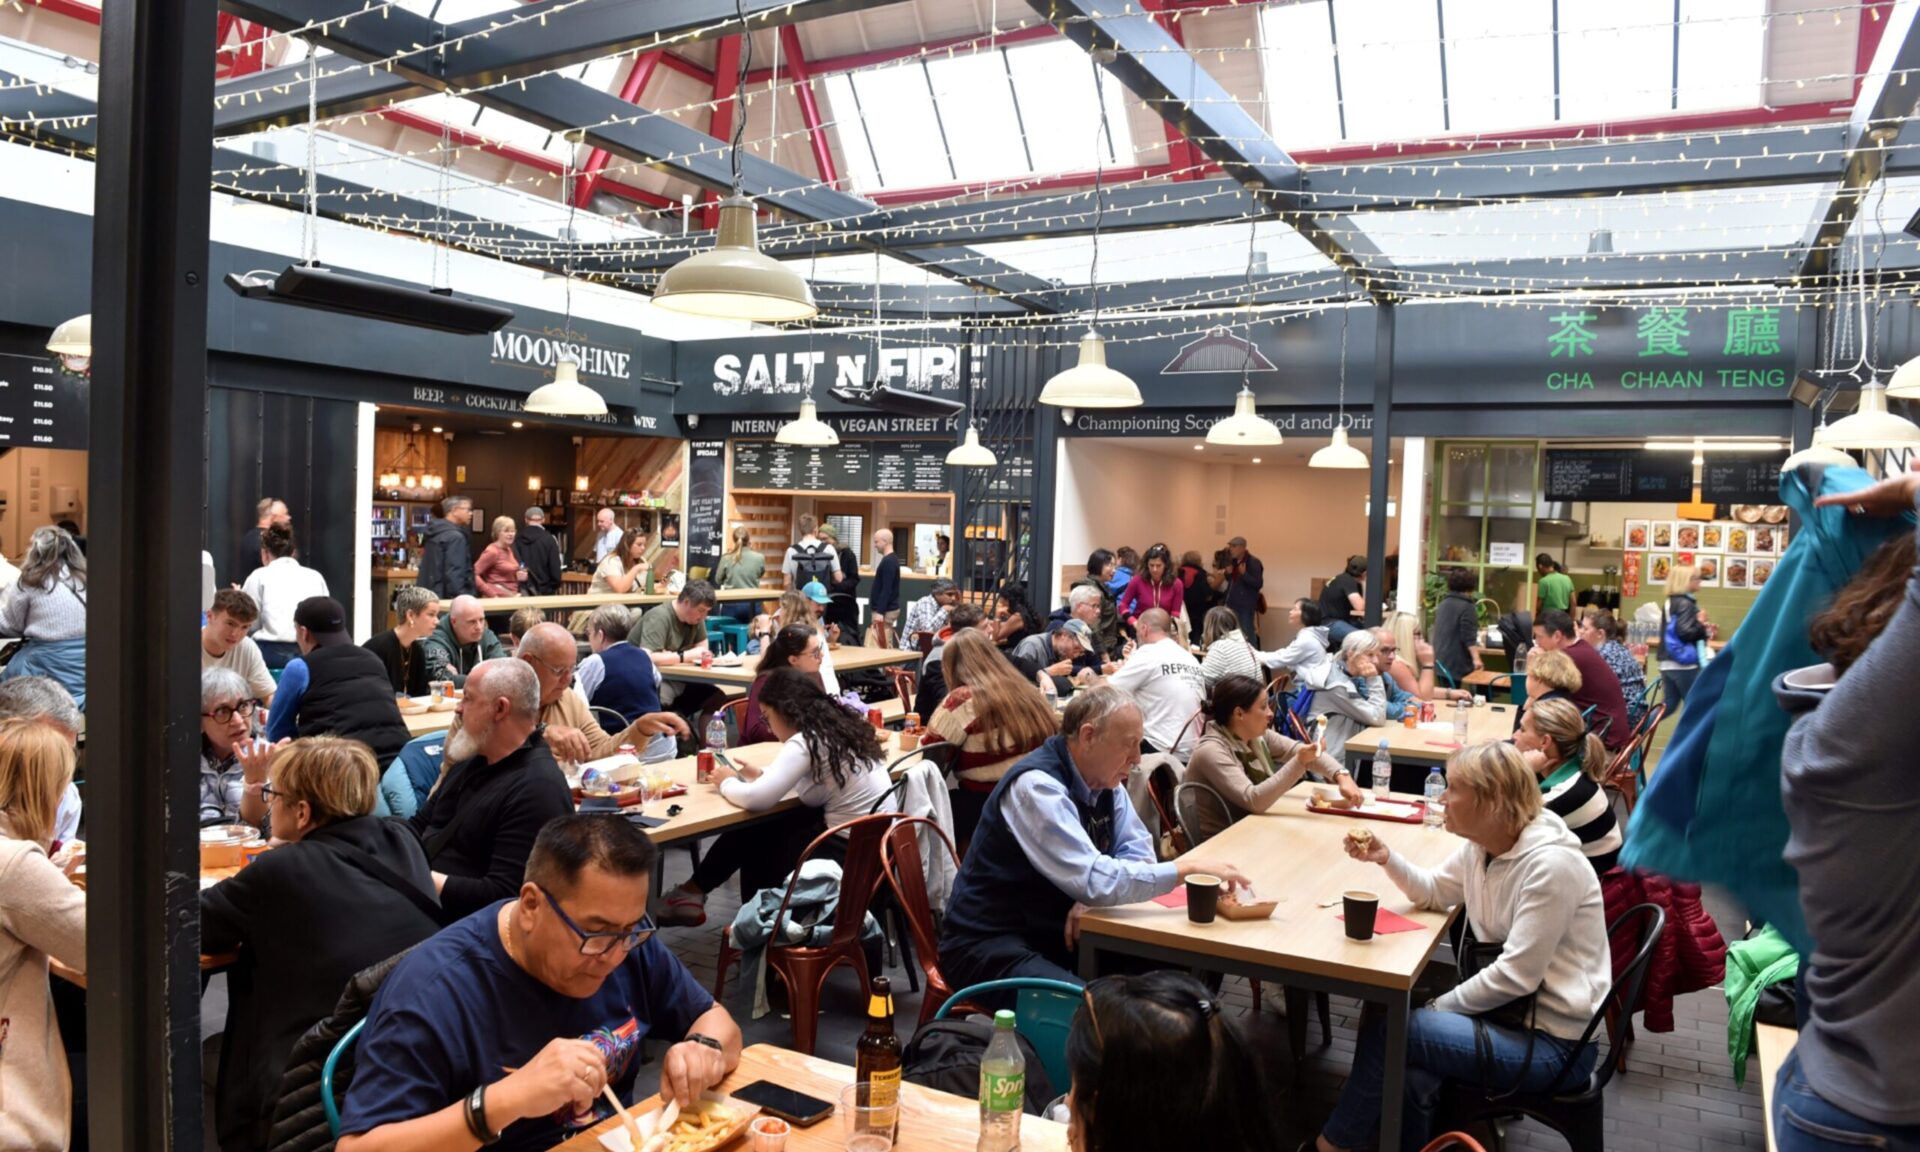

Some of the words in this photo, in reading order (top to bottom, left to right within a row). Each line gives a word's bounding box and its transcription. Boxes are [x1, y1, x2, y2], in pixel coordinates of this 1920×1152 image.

[1548, 306, 1781, 358] 茶餐廳
[491, 330, 631, 379] MOONSHINE
[713, 351, 825, 396] SALT
[835, 354, 867, 387] N
[1546, 372, 1595, 390] CHA
[1620, 370, 1704, 389] CHAAN
[1717, 369, 1785, 388] TENG
[413, 386, 445, 404] BEER
[465, 393, 527, 413] COCKTAILS
[633, 415, 658, 429] WINE
[1077, 414, 1181, 434] Championing
[1300, 412, 1332, 430] and
[840, 418, 888, 432] VEGAN
[891, 416, 939, 432] STREET
[993, 1078, 1023, 1098] Spri
